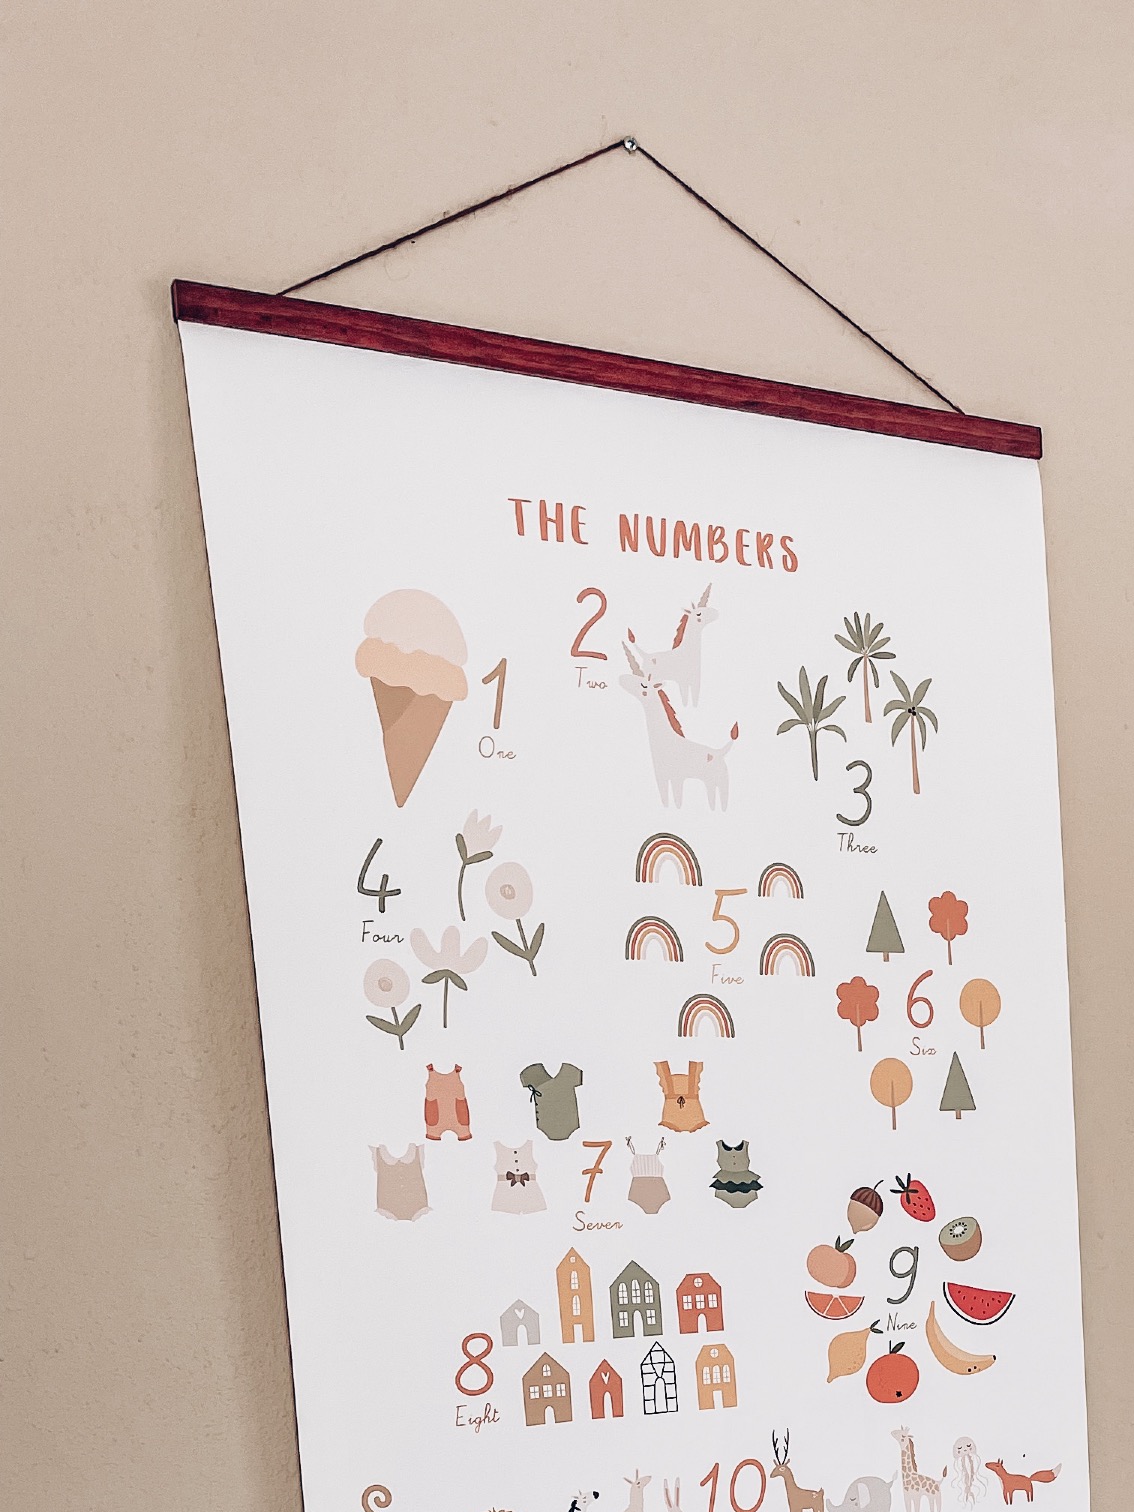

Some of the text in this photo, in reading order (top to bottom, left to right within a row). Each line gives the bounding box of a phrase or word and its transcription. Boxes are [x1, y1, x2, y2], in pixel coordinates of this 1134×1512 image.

[508, 498, 799, 573] THE NUMBERS
[570, 587, 608, 661] 2
[481, 657, 508, 730] 1
[574, 666, 609, 690] Two
[478, 735, 517, 761] One
[835, 760, 873, 827] 3
[836, 832, 879, 855] Three
[356, 837, 402, 914] 4
[361, 919, 405, 944] Four
[704, 888, 749, 955] 5
[711, 963, 746, 986] Five
[906, 969, 935, 1029] 6
[909, 1036, 938, 1057] Six
[581, 1140, 613, 1204] 7
[572, 1210, 624, 1233] Seven
[886, 1245, 920, 1305] 9
[886, 1312, 918, 1332] Nine
[454, 1332, 495, 1397] 8
[455, 1403, 501, 1434] Eight
